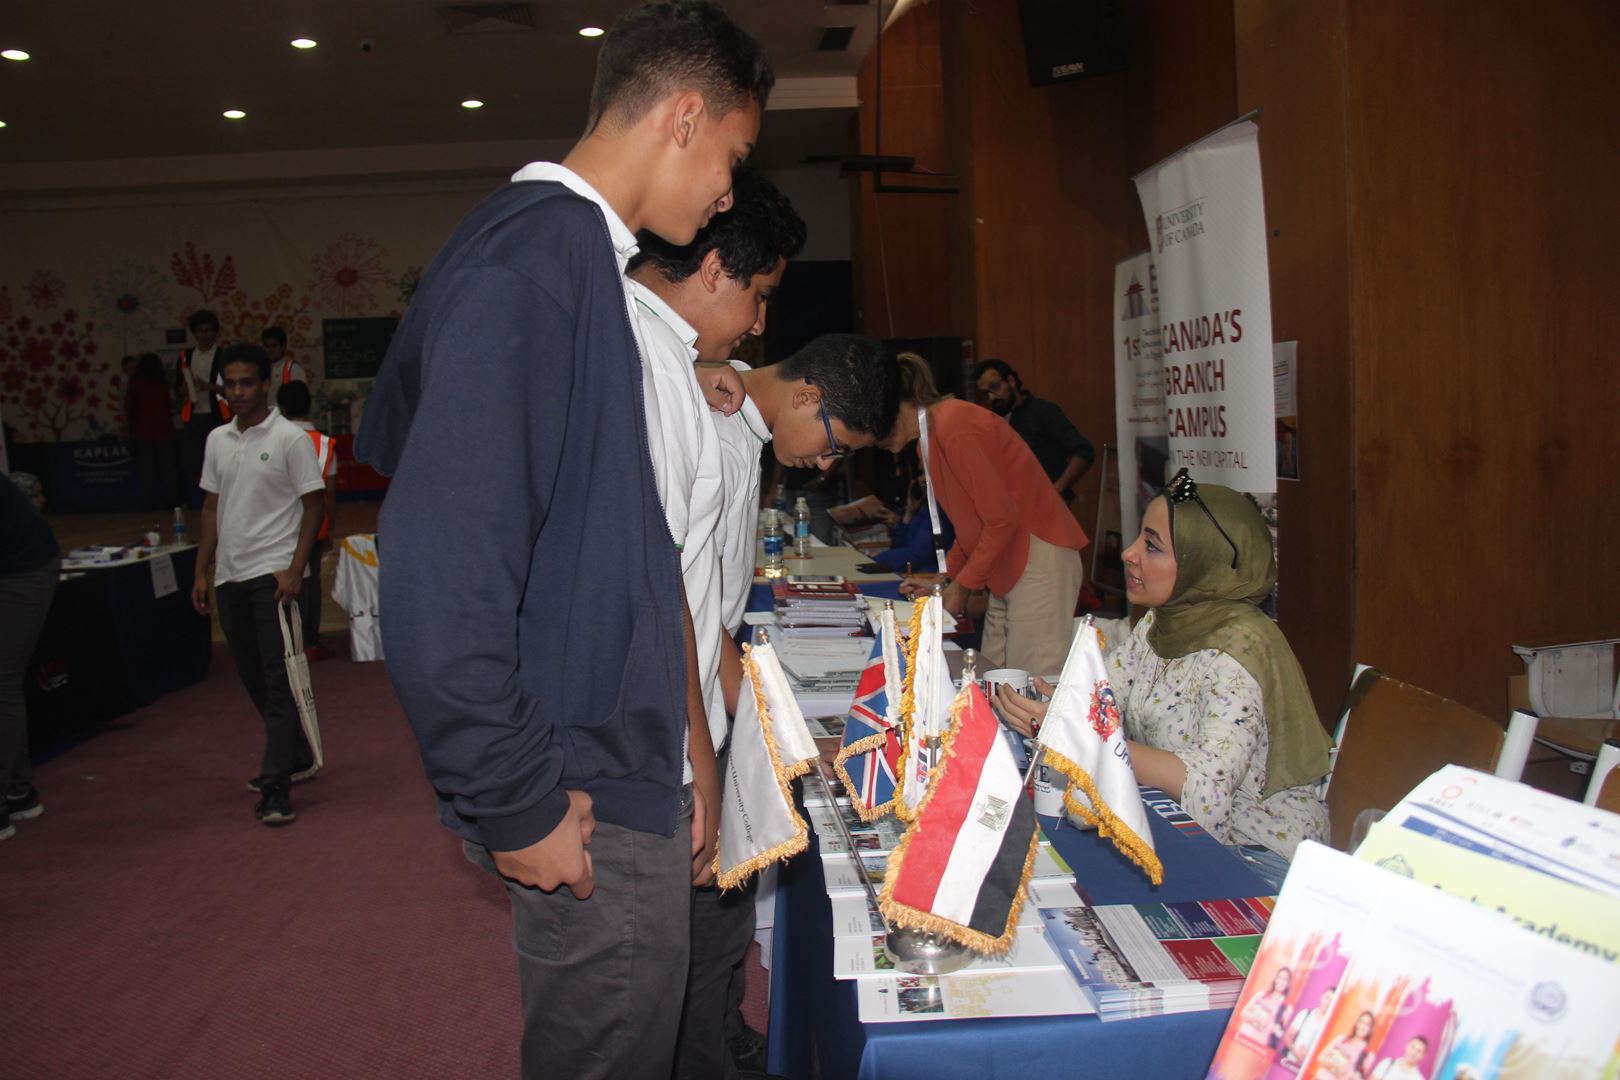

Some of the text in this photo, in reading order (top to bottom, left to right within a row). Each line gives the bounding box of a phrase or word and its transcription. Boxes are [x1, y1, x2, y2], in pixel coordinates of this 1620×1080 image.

[1163, 309, 1242, 354] CANADA'S
[1165, 359, 1225, 395] BRANCH
[1168, 405, 1227, 438] CAMPUS
[1176, 449, 1194, 466] THE
[732, 771, 754, 844] University College
